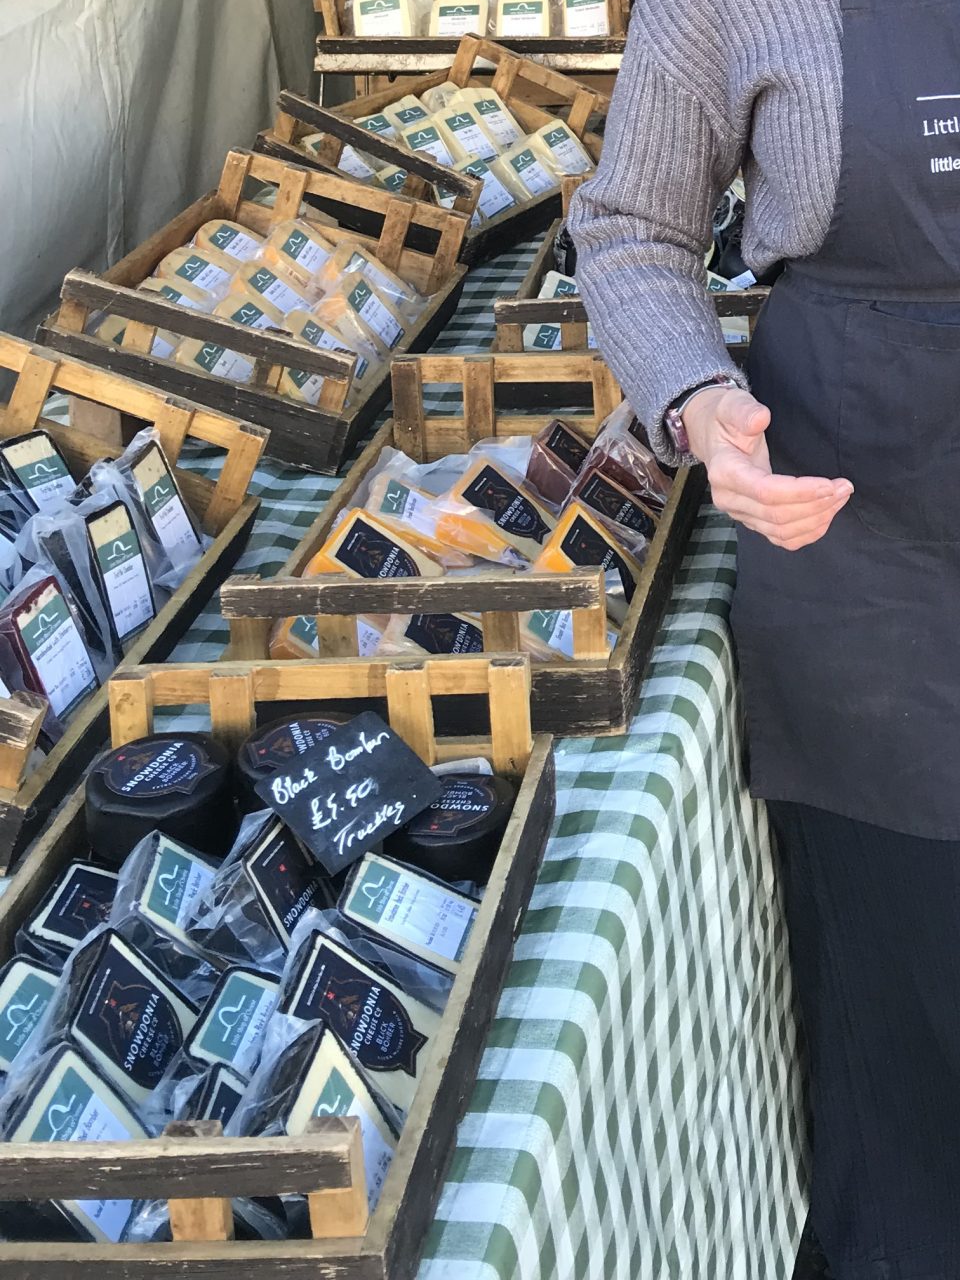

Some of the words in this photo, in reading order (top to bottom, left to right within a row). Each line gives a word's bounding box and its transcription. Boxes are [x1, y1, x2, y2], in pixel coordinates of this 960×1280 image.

[377, 545, 400, 580] OWDONIA
[600, 549, 615, 569] DONIA
[452, 622, 468, 654] OWDONIA
[288, 721, 308, 754] WDONIA
[120, 739, 184, 792] SNOWDONIA
[144, 760, 169, 782] CHEESE
[271, 767, 318, 805] Black
[429, 803, 489, 811] SNOWDO
[123, 992, 160, 1071] SNOWDONIA
[348, 985, 381, 1057] SNOWDONIA
[362, 1017, 378, 1045] CHEESE
[375, 1020, 389, 1044] BLACK
[380, 1021, 396, 1053] BOMBER
[137, 1027, 155, 1058] CHEESE
